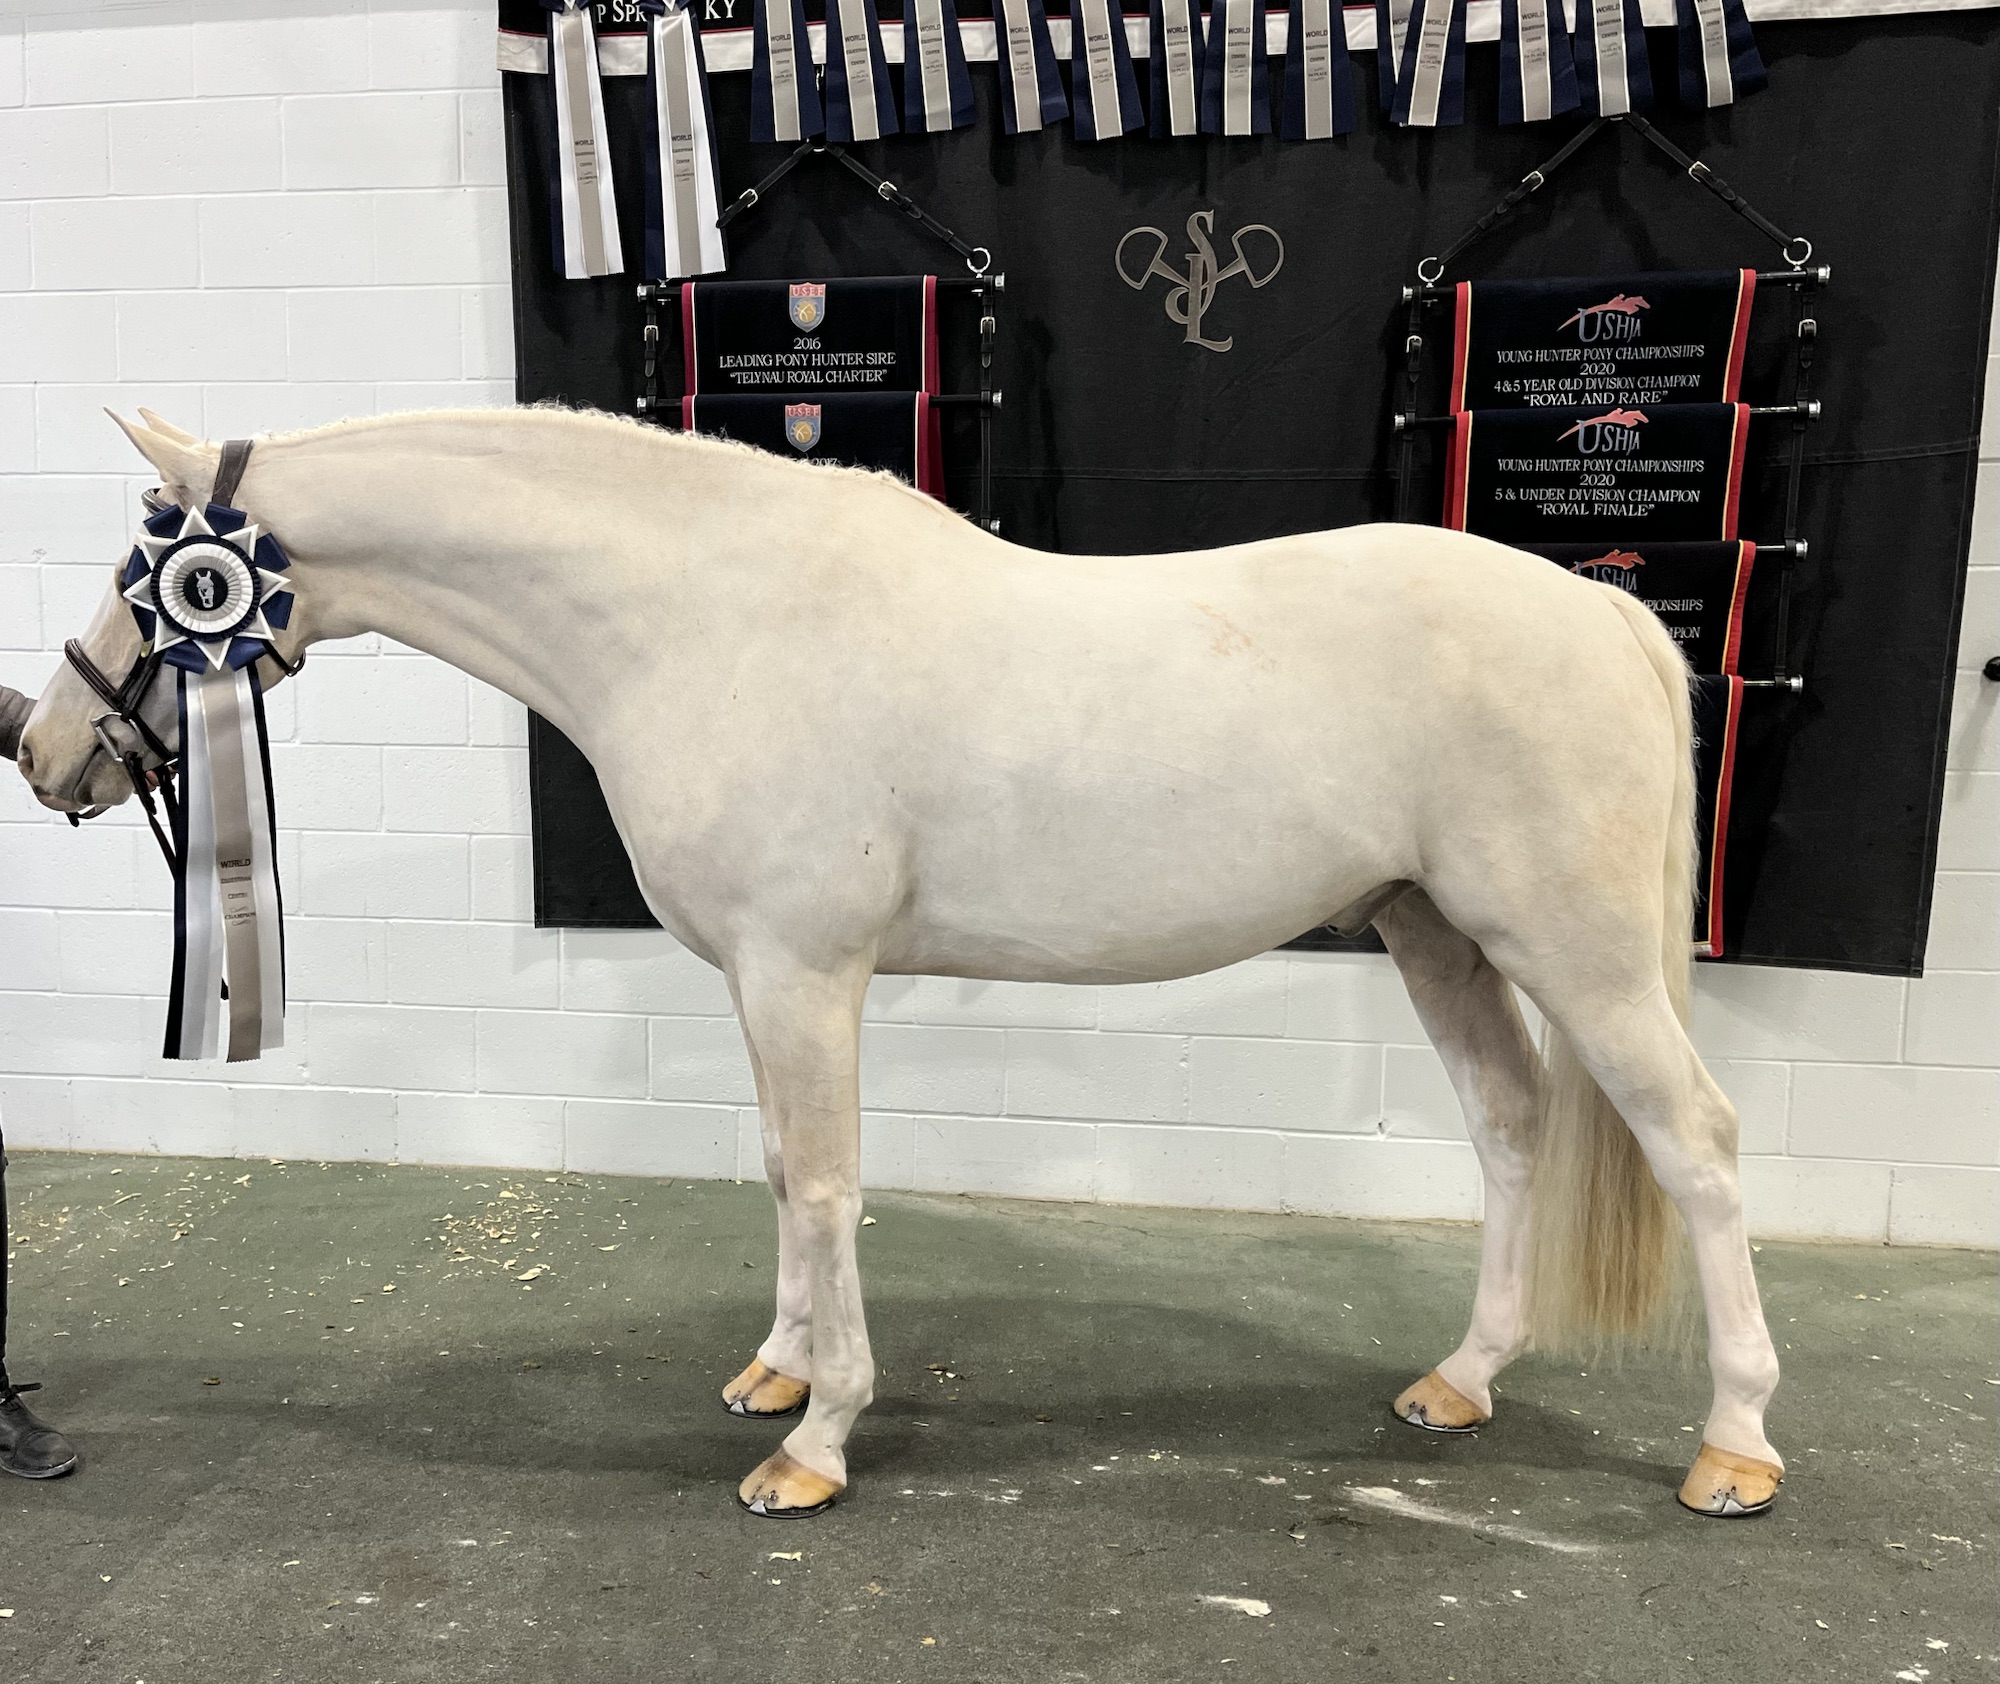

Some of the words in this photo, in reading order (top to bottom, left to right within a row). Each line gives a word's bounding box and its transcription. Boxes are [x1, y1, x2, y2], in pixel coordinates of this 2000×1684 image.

[596, 3, 606, 23] P
[1596, 4, 1620, 13] WORLD
[1522, 11, 1544, 20] WORLD
[920, 24, 941, 32] WORLD
[1167, 26, 1188, 34] WORLD
[1306, 30, 1328, 38] WORLD
[845, 34, 866, 42] WORLD
[1088, 34, 1109, 42] WORLD
[793, 337, 821, 350] 2016
[719, 353, 773, 368] LEADING
[775, 353, 809, 367] PONY
[811, 352, 864, 366] HUNTER
[865, 351, 896, 365] SIRE
[1497, 350, 1533, 364] YOUNG
[1535, 348, 1581, 363] HUNTER
[1583, 347, 1614, 362] PONY
[1615, 345, 1705, 361] CHAMPIONSHIPS
[1580, 363, 1616, 376] 2020
[786, 370, 823, 384] ROYAL
[825, 369, 888, 383] CHARTER”
[1523, 378, 1556, 392] YEAR
[1558, 378, 1583, 391] OLD
[1585, 376, 1636, 390] DIVISION
[1637, 374, 1701, 389] CHAMPION
[1523, 393, 1577, 407] “ROYAL
[1581, 392, 1615, 405] AND
[1618, 390, 1669, 404] RARE”
[1498, 458, 1533, 472] YOUNG
[1535, 459, 1581, 472] HUNTER
[1583, 459, 1614, 472] PONY
[1615, 459, 1705, 473] CHAMPIONSHIPS
[1580, 474, 1616, 486] 2020
[1494, 488, 1503, 501] 5
[1505, 489, 1517, 500] &
[1519, 488, 1565, 501] UNDER
[1568, 488, 1626, 502] DIVISION
[1628, 489, 1701, 503] CHAMPION
[1536, 503, 1590, 516] “ROYAL
[1593, 503, 1656, 517] FINALE”
[1644, 598, 1704, 611] PIONSHIPS
